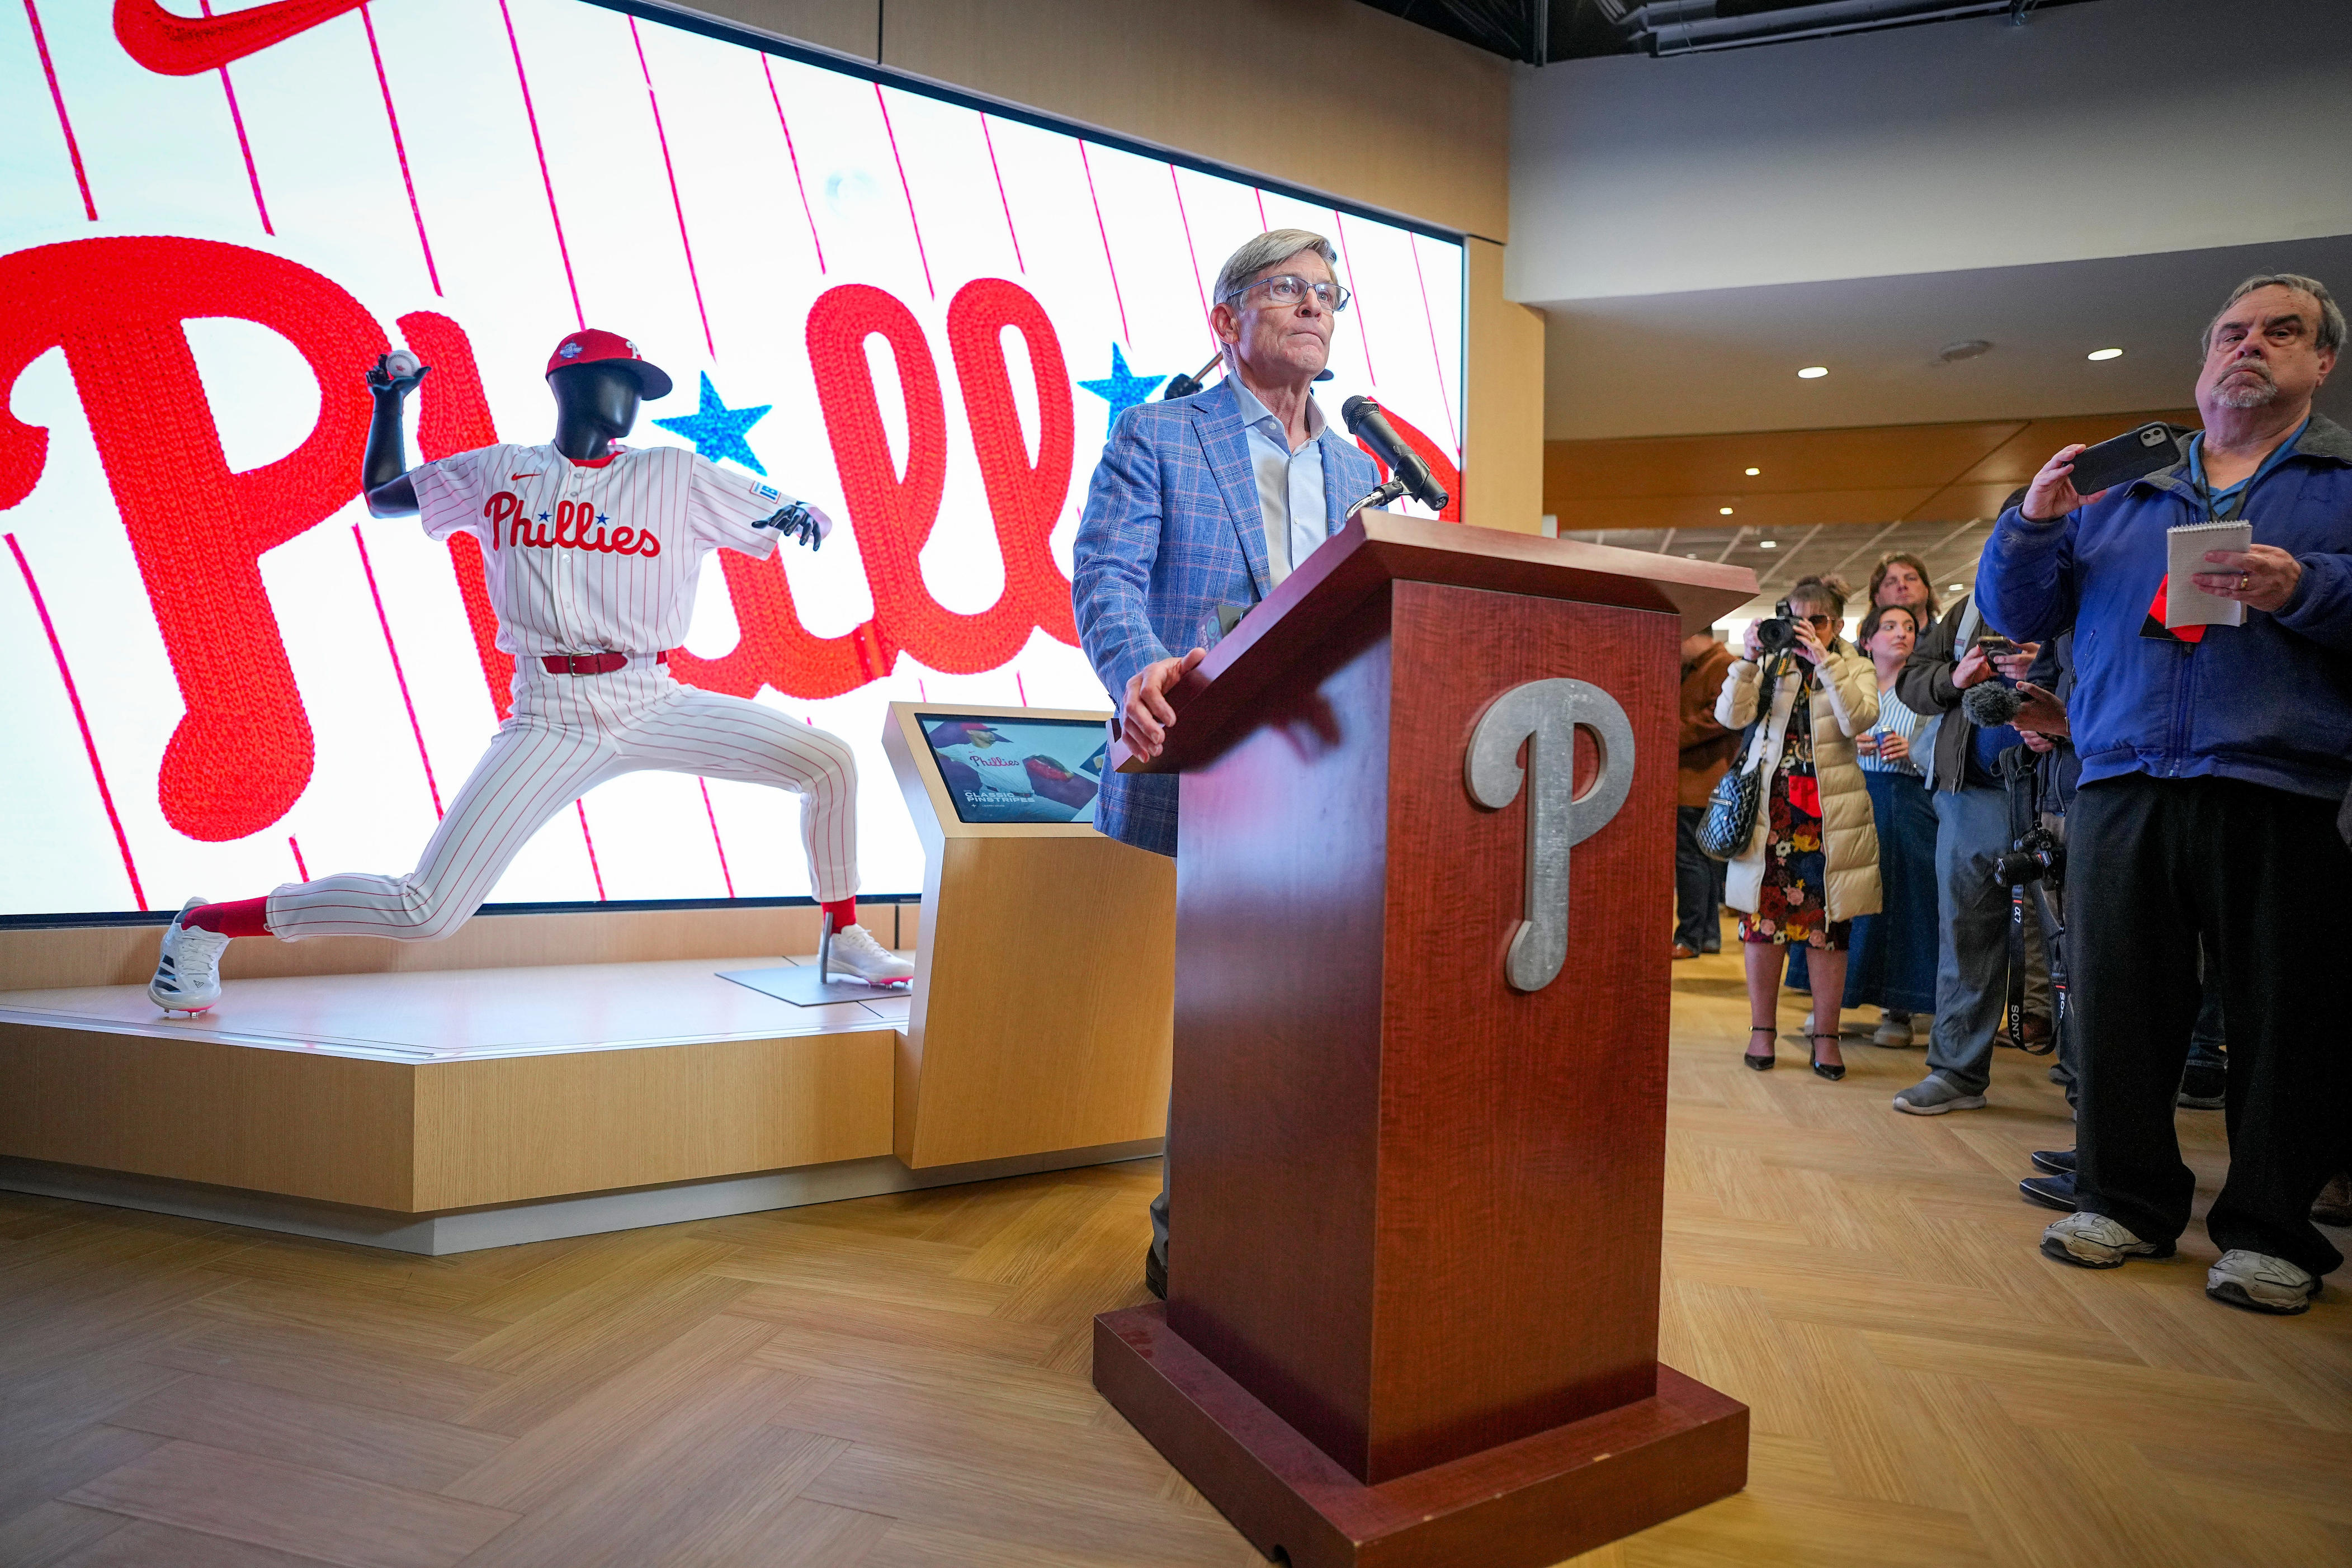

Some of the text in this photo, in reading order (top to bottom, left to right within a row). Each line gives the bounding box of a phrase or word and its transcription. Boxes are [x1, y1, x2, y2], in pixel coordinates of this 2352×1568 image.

[0, 236, 1461, 841] Phill
[484, 492, 660, 558] Phillies
[970, 755, 1019, 766] Phillies
[1464, 678, 1635, 991] P
[2011, 1004, 2020, 1041] SONY
